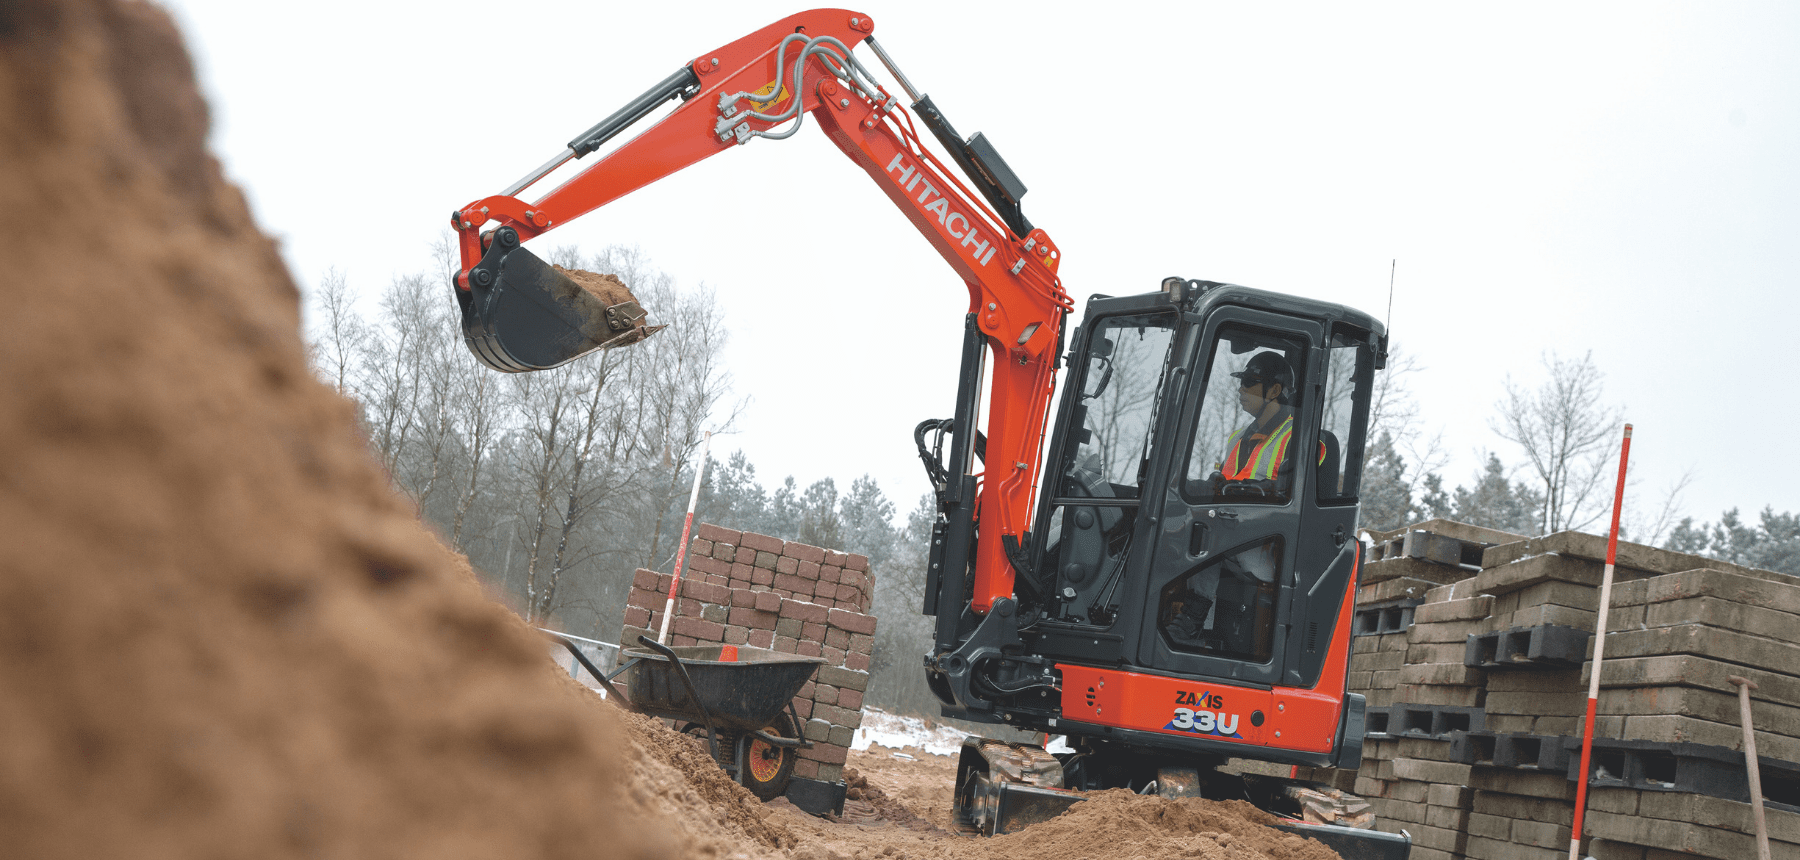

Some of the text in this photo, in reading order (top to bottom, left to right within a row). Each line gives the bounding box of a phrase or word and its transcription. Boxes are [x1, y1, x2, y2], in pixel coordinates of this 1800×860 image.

[886, 152, 997, 267] HITACHI
[1175, 690, 1223, 709] ZAXIS
[1172, 707, 1239, 736] 33U
